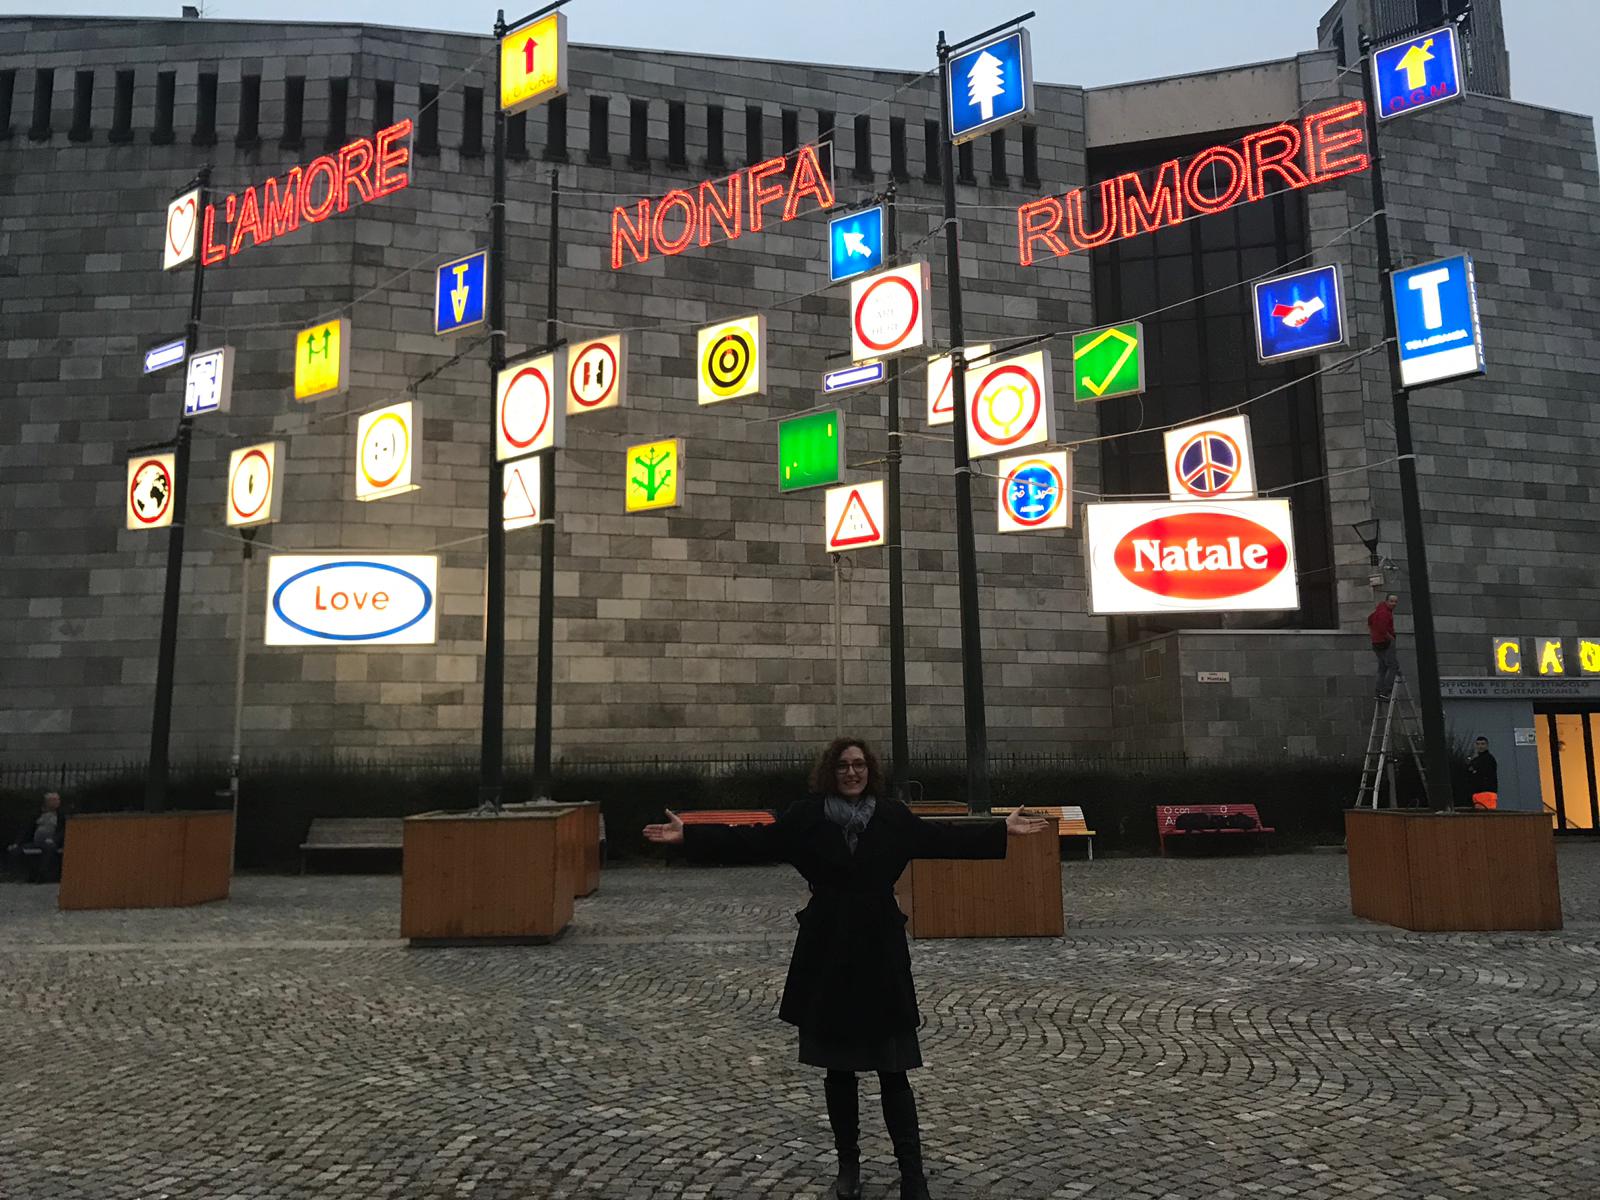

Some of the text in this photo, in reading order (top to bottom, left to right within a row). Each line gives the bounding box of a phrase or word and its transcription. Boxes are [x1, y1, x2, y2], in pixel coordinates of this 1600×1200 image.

[202, 117, 413, 266] L'AMORE
[1018, 101, 1371, 267] RUMORE
[1132, 537, 1268, 572] Natale
[314, 585, 390, 612] Love
